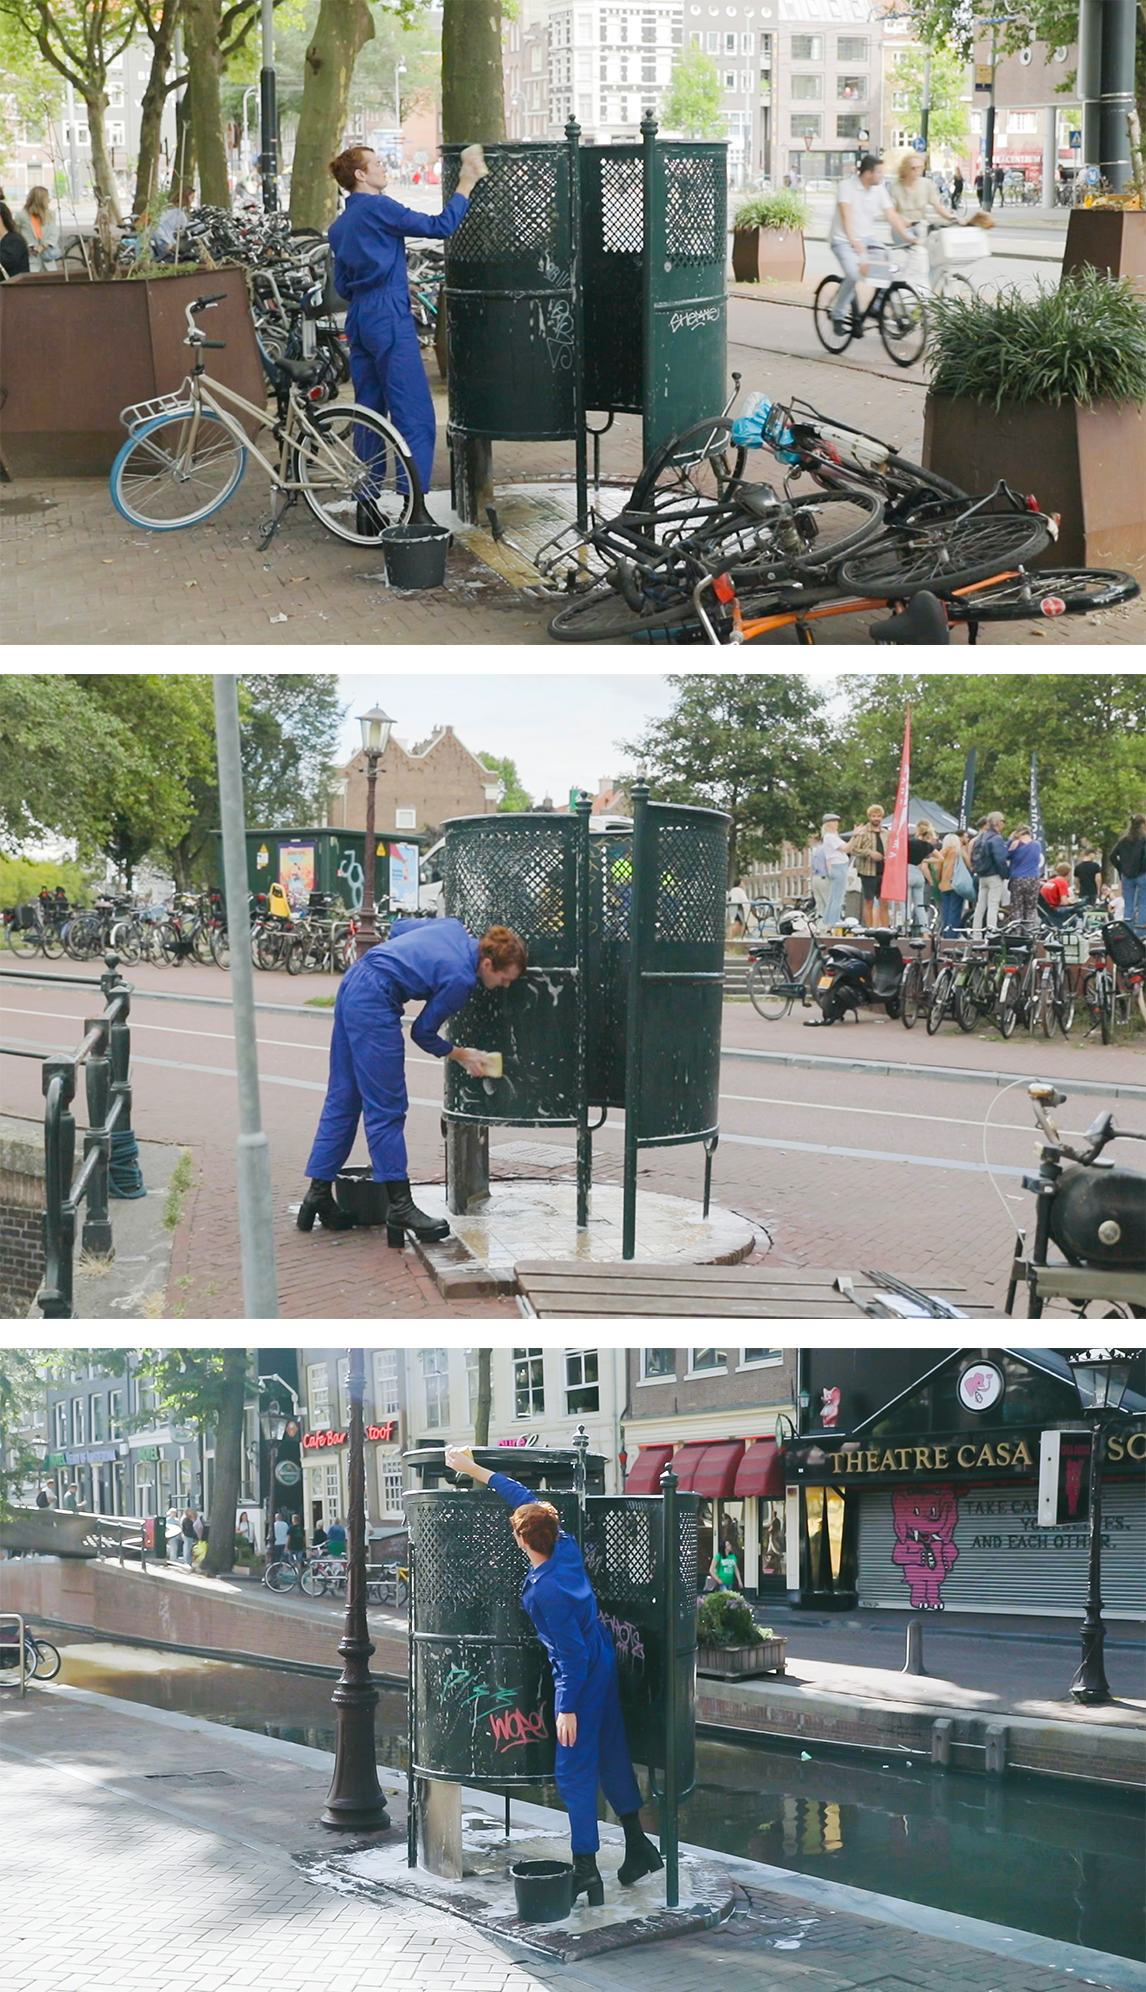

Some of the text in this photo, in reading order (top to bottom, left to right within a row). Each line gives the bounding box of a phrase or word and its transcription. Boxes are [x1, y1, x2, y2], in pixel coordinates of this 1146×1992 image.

[303, 1431, 327, 1449] Cafe
[326, 1430, 347, 1447] Bar
[829, 1446, 949, 1473] THEATRE
[957, 1440, 1033, 1468] CASA
[965, 1501, 1006, 1515] TAKE
[973, 1534, 1116, 1549] AND EACH OTHR.
